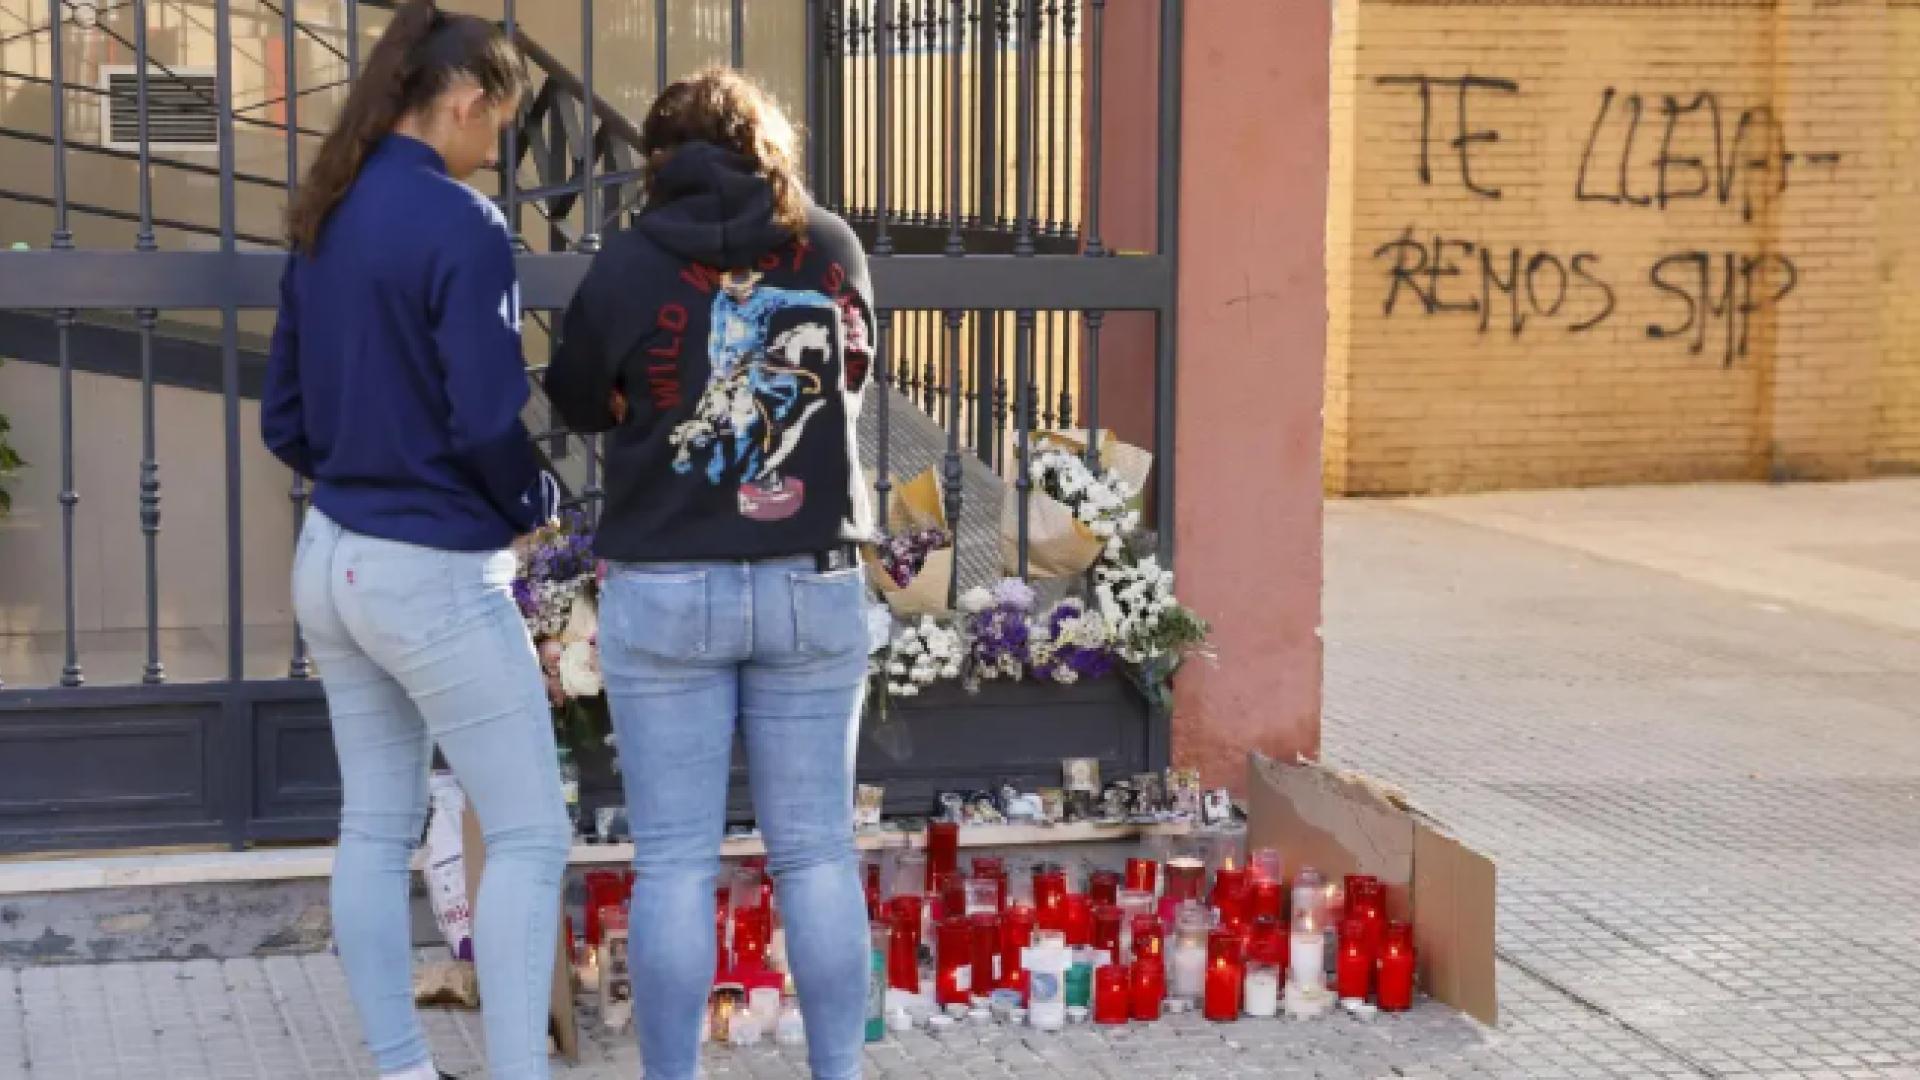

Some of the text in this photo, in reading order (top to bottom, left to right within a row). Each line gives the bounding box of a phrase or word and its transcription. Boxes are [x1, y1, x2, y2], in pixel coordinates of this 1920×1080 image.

[1374, 75, 1519, 198] TE
[648, 238, 816, 411] WILD WST
[1373, 227, 1798, 368] REMOS SMP
